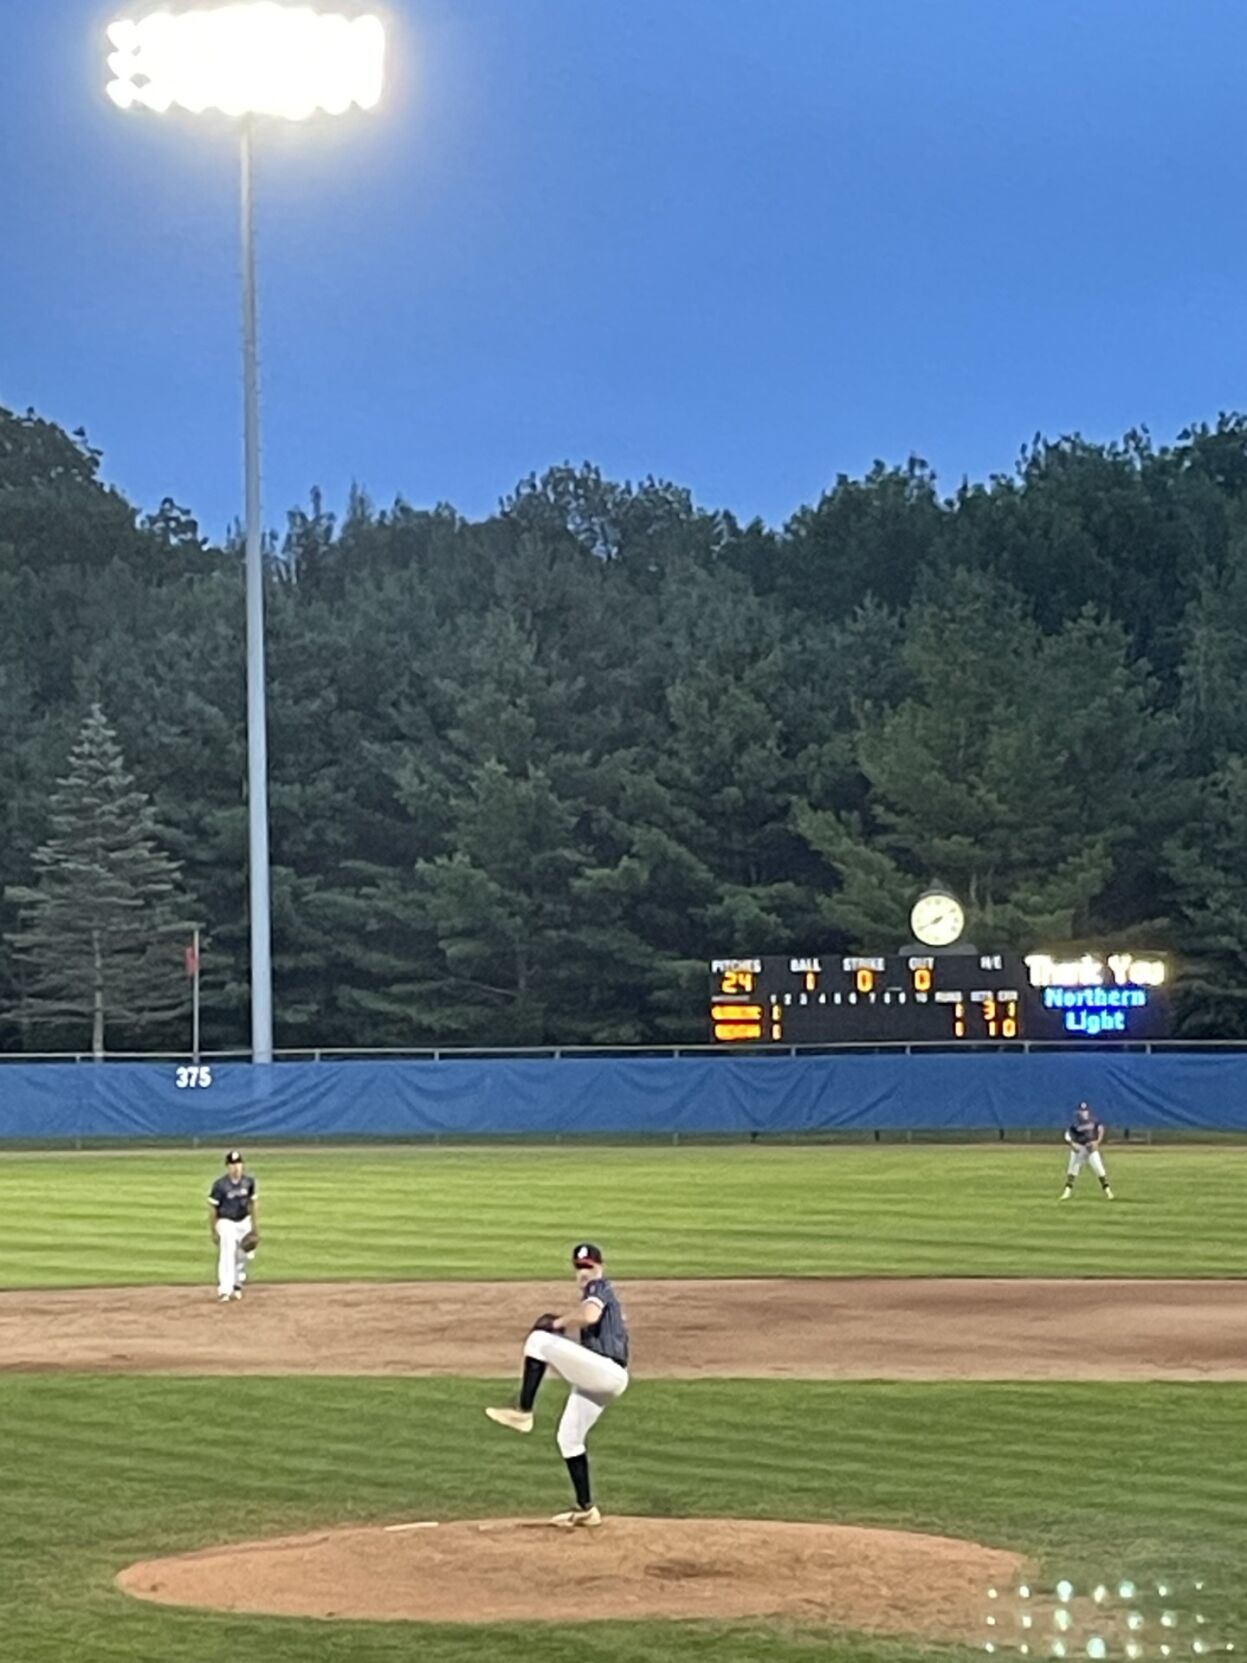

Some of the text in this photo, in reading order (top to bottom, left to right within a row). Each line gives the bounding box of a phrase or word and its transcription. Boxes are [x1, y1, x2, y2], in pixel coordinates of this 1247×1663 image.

[790, 958, 821, 972] BALL
[843, 957, 885, 971] STRIKE
[909, 957, 934, 971] OUT
[1025, 954, 1164, 986] Thank You
[722, 969, 930, 993] 24 1 0 0
[1044, 987, 1146, 1008] Northern
[983, 1000, 995, 1020] 3
[989, 1021, 996, 1037] 1
[1003, 1019, 1016, 1037] 0
[1065, 1009, 1125, 1034] Light
[176, 1066, 212, 1088] 375
